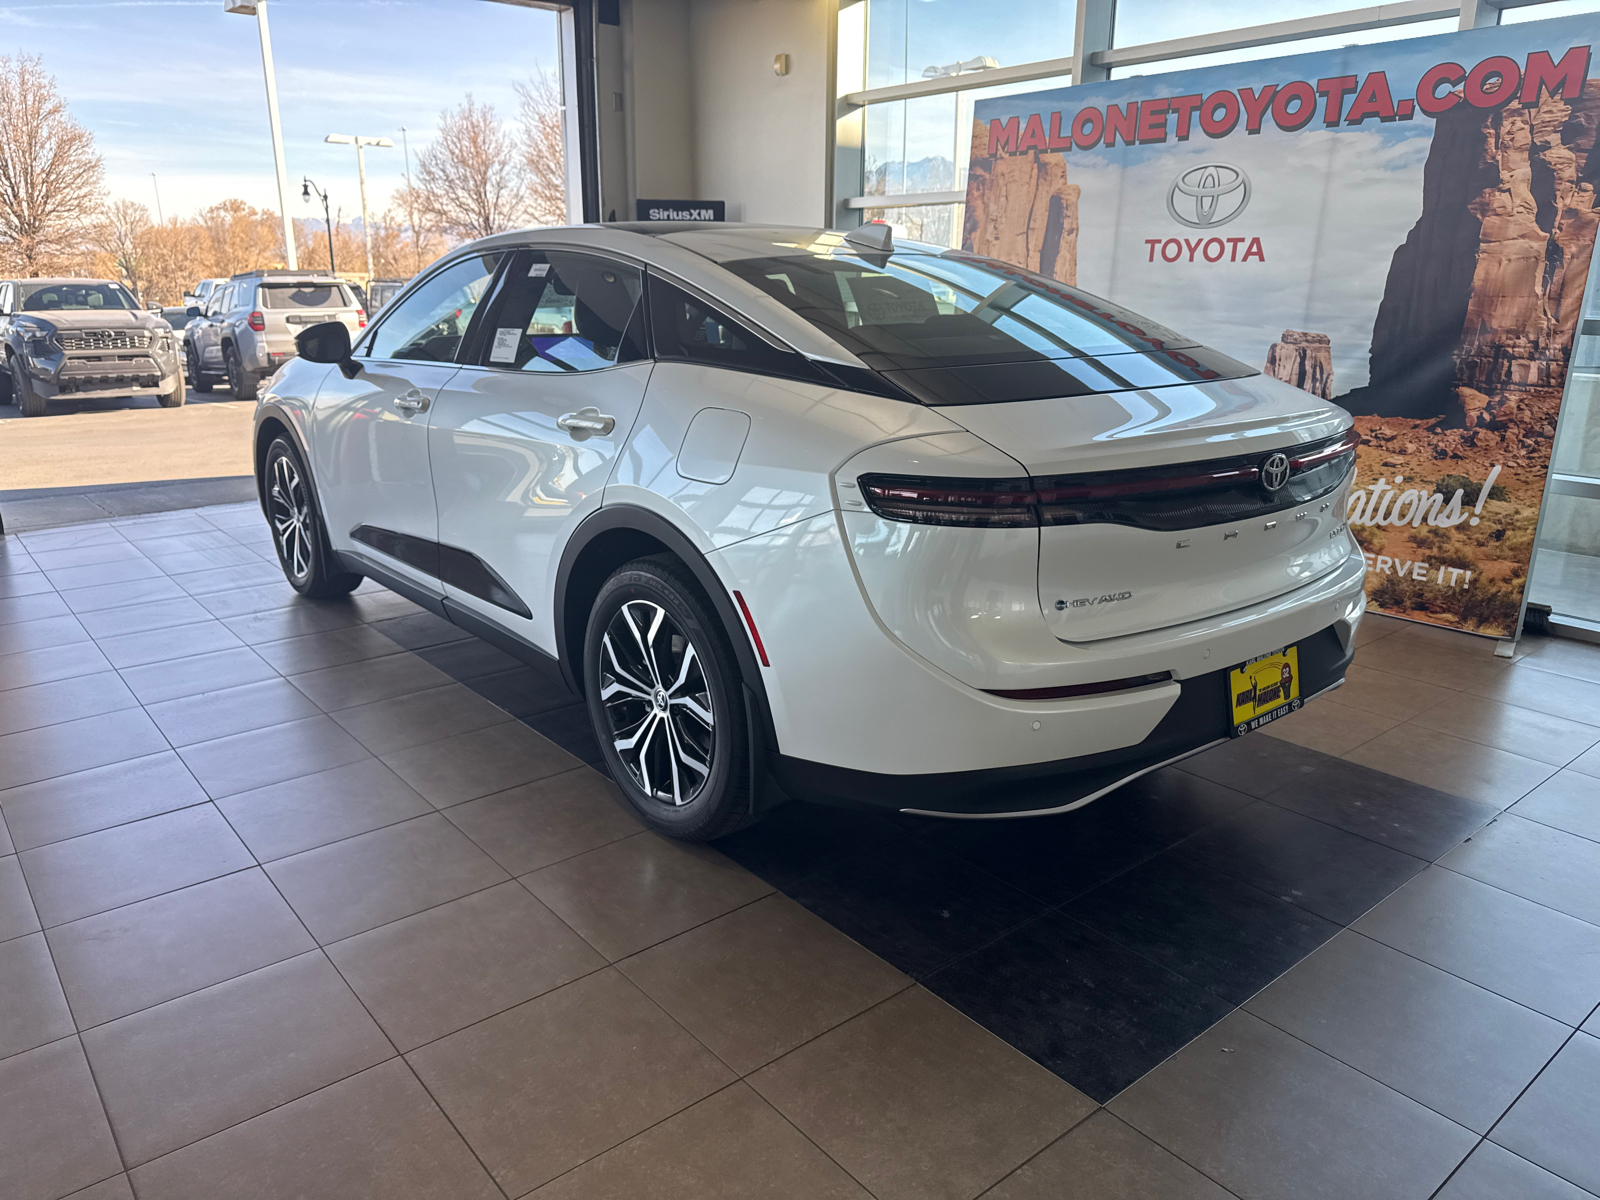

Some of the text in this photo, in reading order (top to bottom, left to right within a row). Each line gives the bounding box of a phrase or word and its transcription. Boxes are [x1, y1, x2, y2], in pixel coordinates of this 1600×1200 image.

[988, 45, 1592, 156] MALONETOYOTA.COM
[649, 208, 714, 220] SiriusXM
[1145, 236, 1266, 263] TOYOTA
[1437, 565, 1472, 589] IT!
[1065, 591, 1133, 608] HEV AWD
[1282, 667, 1290, 678] 32
[1251, 720, 1258, 729] WE
[1260, 713, 1272, 724] MAKE
[1278, 705, 1289, 716] EASY
